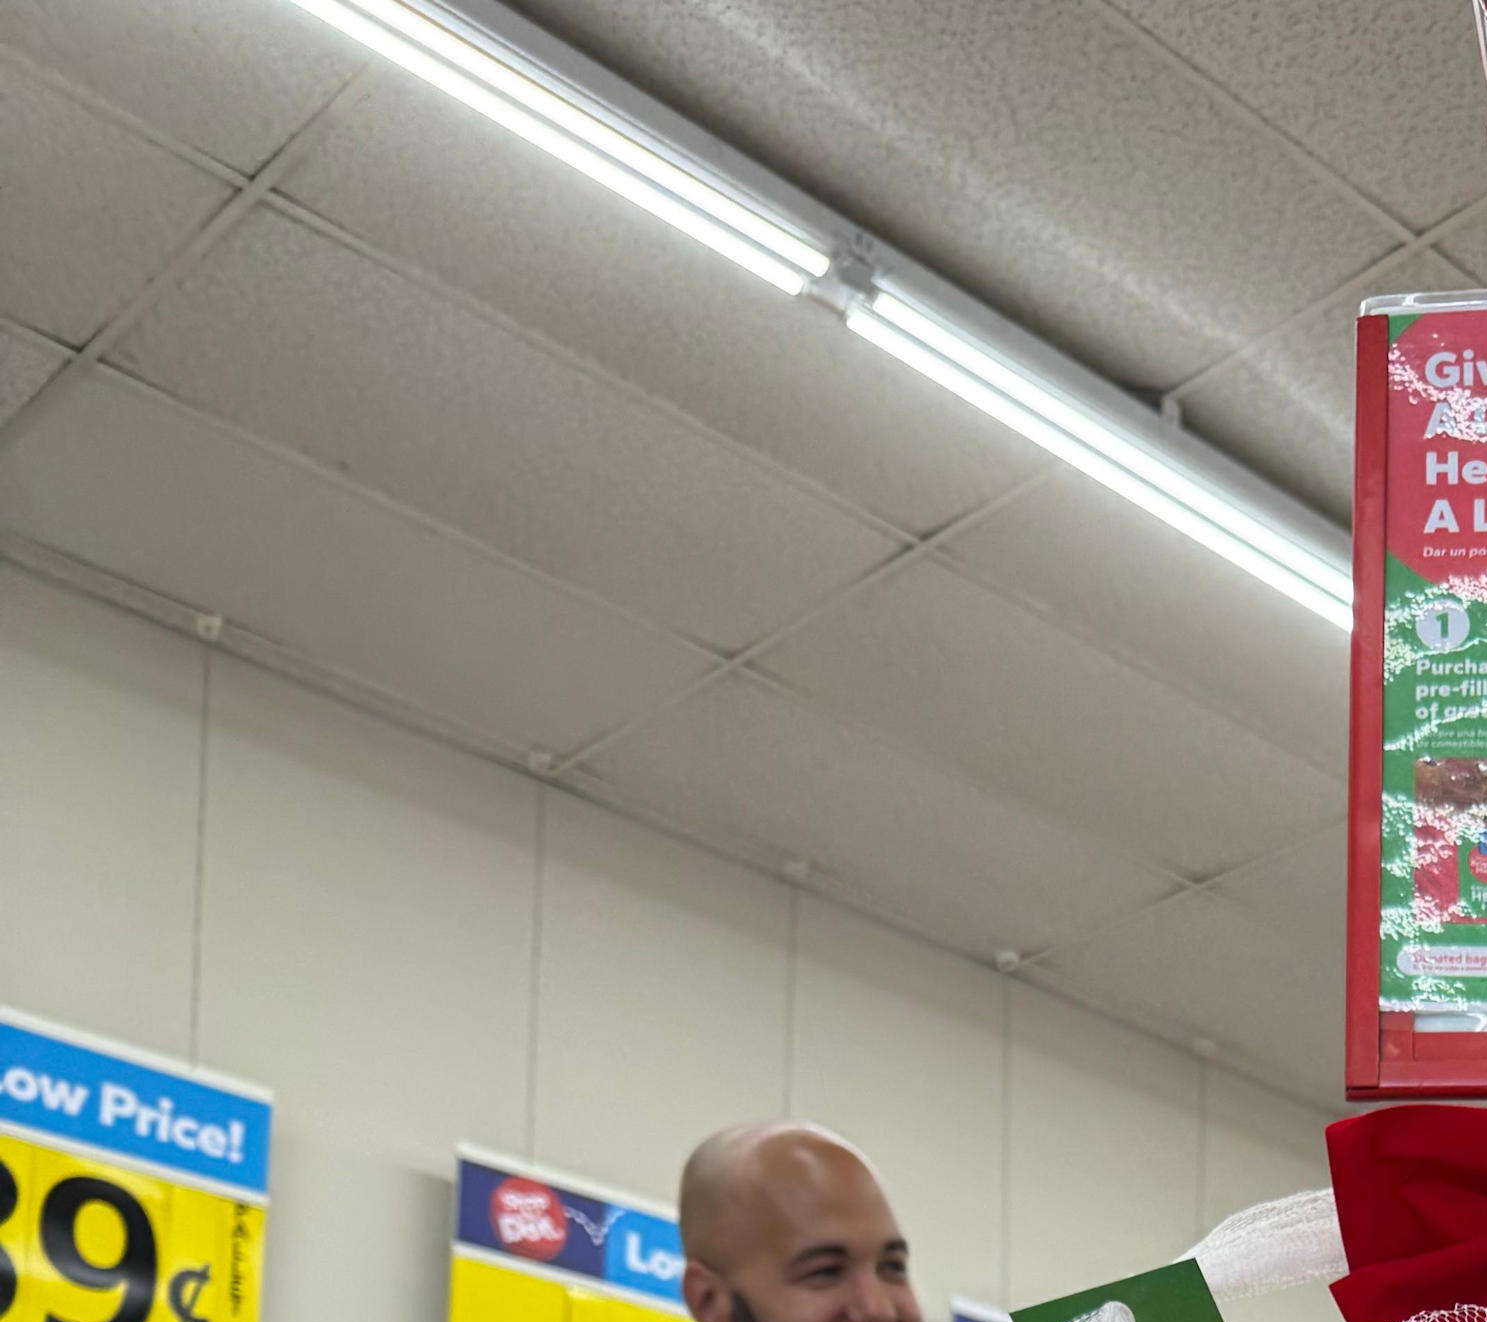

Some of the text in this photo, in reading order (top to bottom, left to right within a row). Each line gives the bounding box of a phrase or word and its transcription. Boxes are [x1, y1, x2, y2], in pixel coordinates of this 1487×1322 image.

[1424, 500, 1462, 534] A
[1423, 548, 1447, 557] Dar
[1450, 548, 1470, 556] un
[1436, 612, 1449, 637] 1
[0, 1066, 246, 1164] ow Price!
